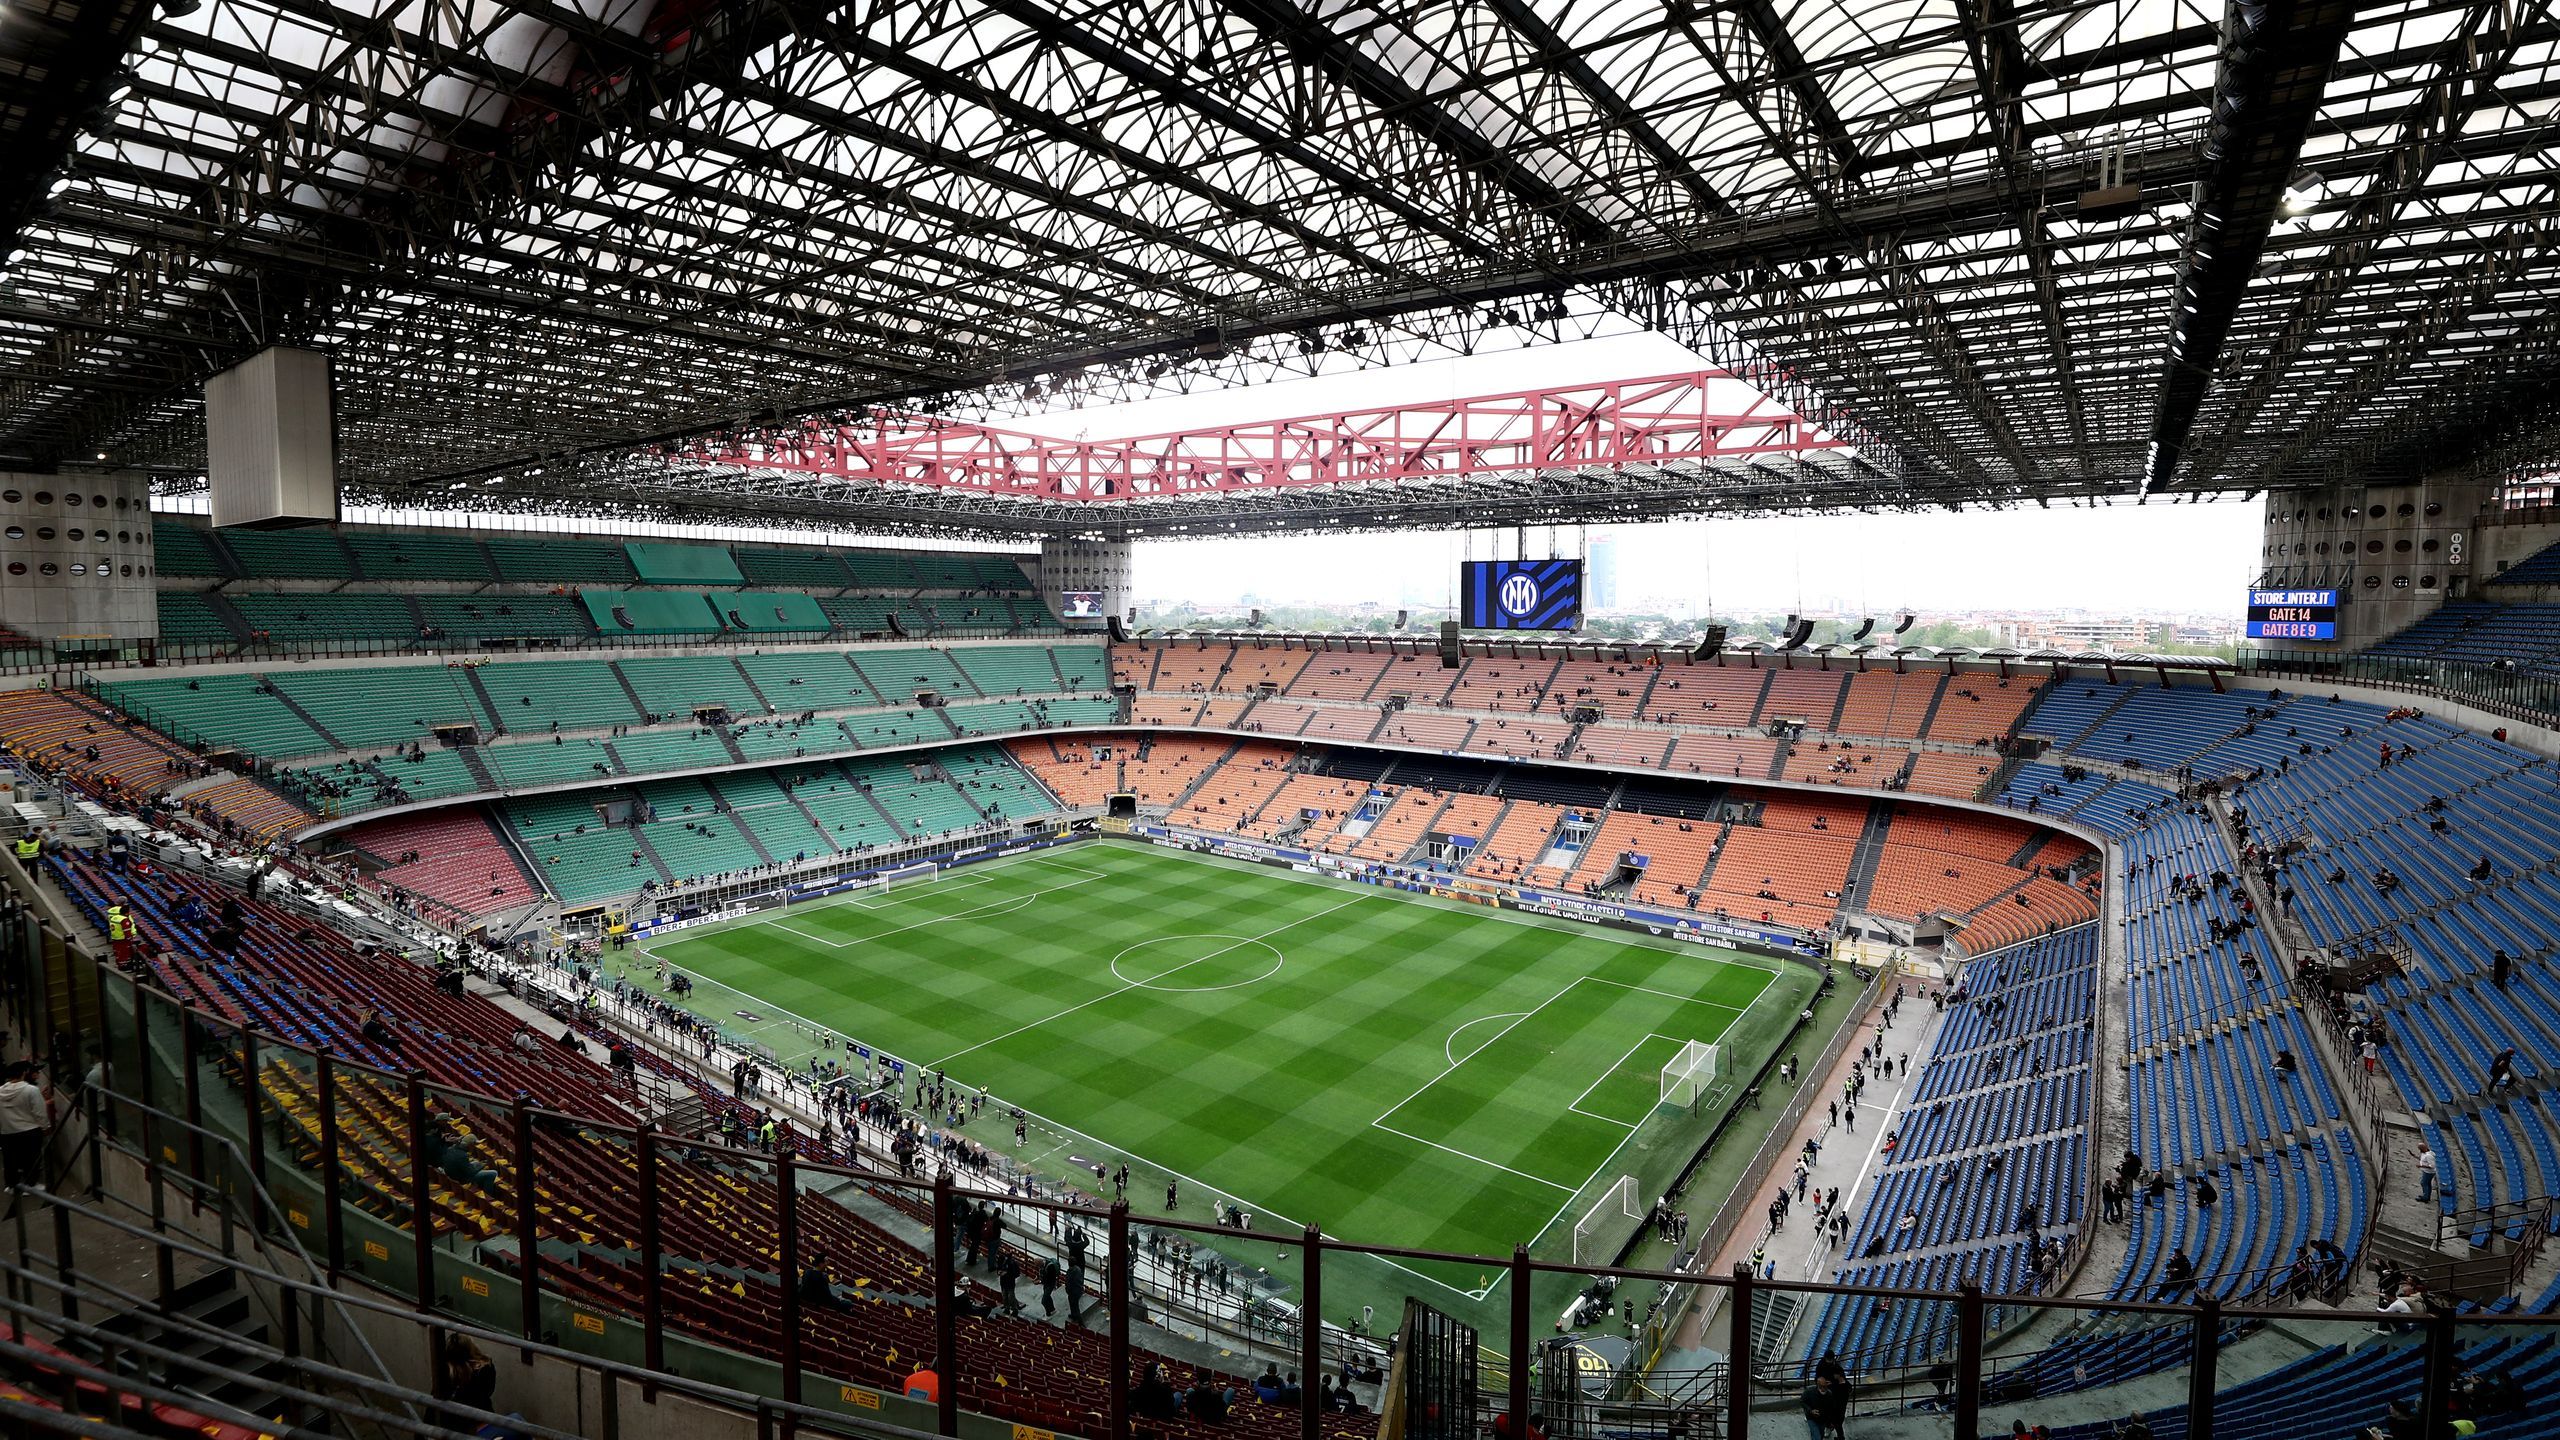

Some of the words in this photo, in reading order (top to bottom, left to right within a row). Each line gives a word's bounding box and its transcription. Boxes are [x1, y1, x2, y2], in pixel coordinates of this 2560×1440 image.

[2254, 592, 2330, 605] STORE.INTER.IT
[2269, 608, 2297, 621] GATE
[2298, 608, 2311, 621] 14
[2262, 623, 2290, 636] GATE
[2290, 624, 2298, 636] 8
[2300, 625, 2307, 636] E
[2308, 624, 2317, 637] 9
[686, 915, 714, 927] BPER:
[654, 922, 682, 934] BPER:
[1701, 922, 1716, 932] INTER
[1716, 926, 1734, 935] STORE
[1734, 928, 1746, 938] SAN
[1746, 930, 1760, 940] SIRO
[1673, 932, 1688, 941] INTER
[1688, 934, 1705, 944] STORE
[1705, 937, 1717, 946] SAN
[1717, 939, 1737, 950] BABILA
